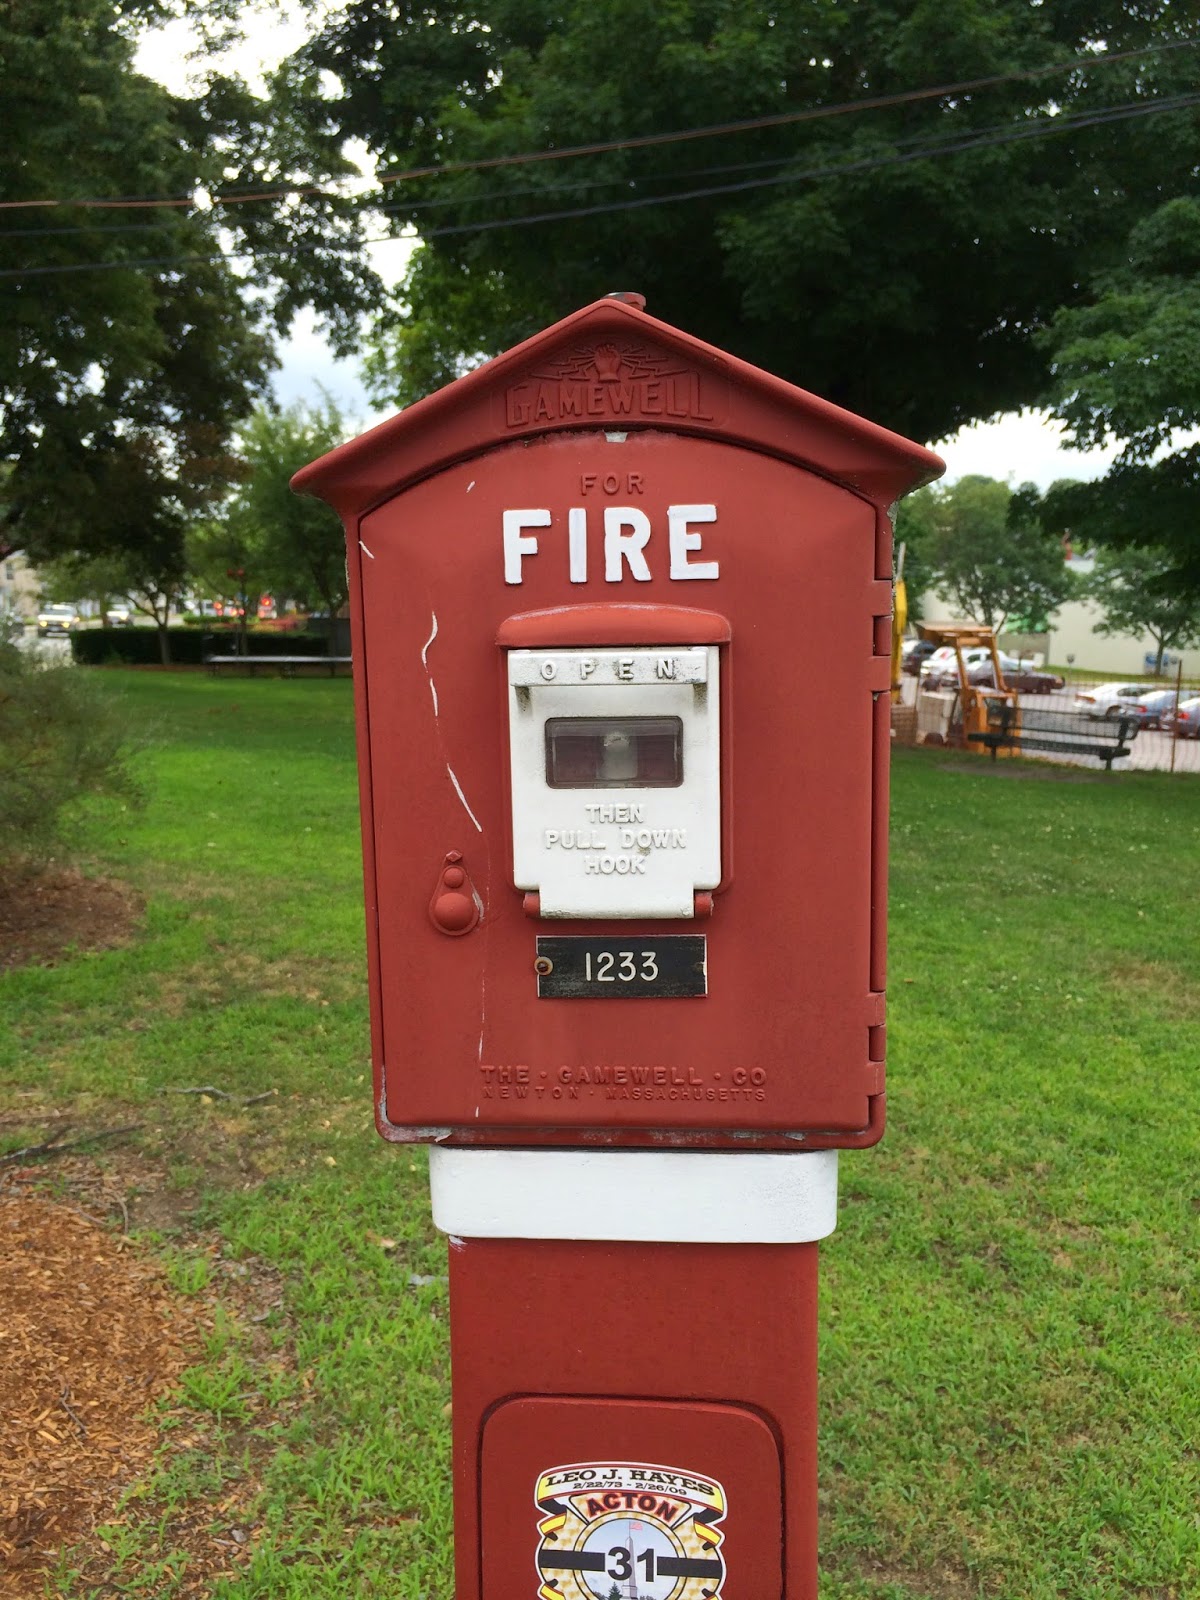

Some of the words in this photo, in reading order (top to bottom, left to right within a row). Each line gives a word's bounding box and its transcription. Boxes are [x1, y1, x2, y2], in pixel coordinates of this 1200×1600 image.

[506, 371, 714, 428] GAMEWELL
[581, 472, 644, 496] FOR
[502, 504, 720, 584] FIRE
[540, 659, 677, 681] OPEN
[585, 803, 645, 823] THEN
[545, 829, 606, 850] PULL
[621, 829, 687, 849] DOWN
[585, 854, 646, 874] HOOK
[585, 951, 660, 982] 1233
[480, 1065, 530, 1084] THE
[559, 1065, 704, 1086] GAMEWELL
[732, 1066, 767, 1086] CO
[483, 1086, 579, 1100] NEWTON
[606, 1087, 766, 1101] MASSACHUSETTS
[545, 1469, 597, 1488] LEO
[602, 1469, 623, 1480] J.
[629, 1469, 715, 1496] HAYES
[573, 1481, 623, 1490] 2/22/73
[635, 1482, 688, 1496] 2/26/09
[586, 1492, 679, 1523] ACTON
[607, 1546, 655, 1583] 31
